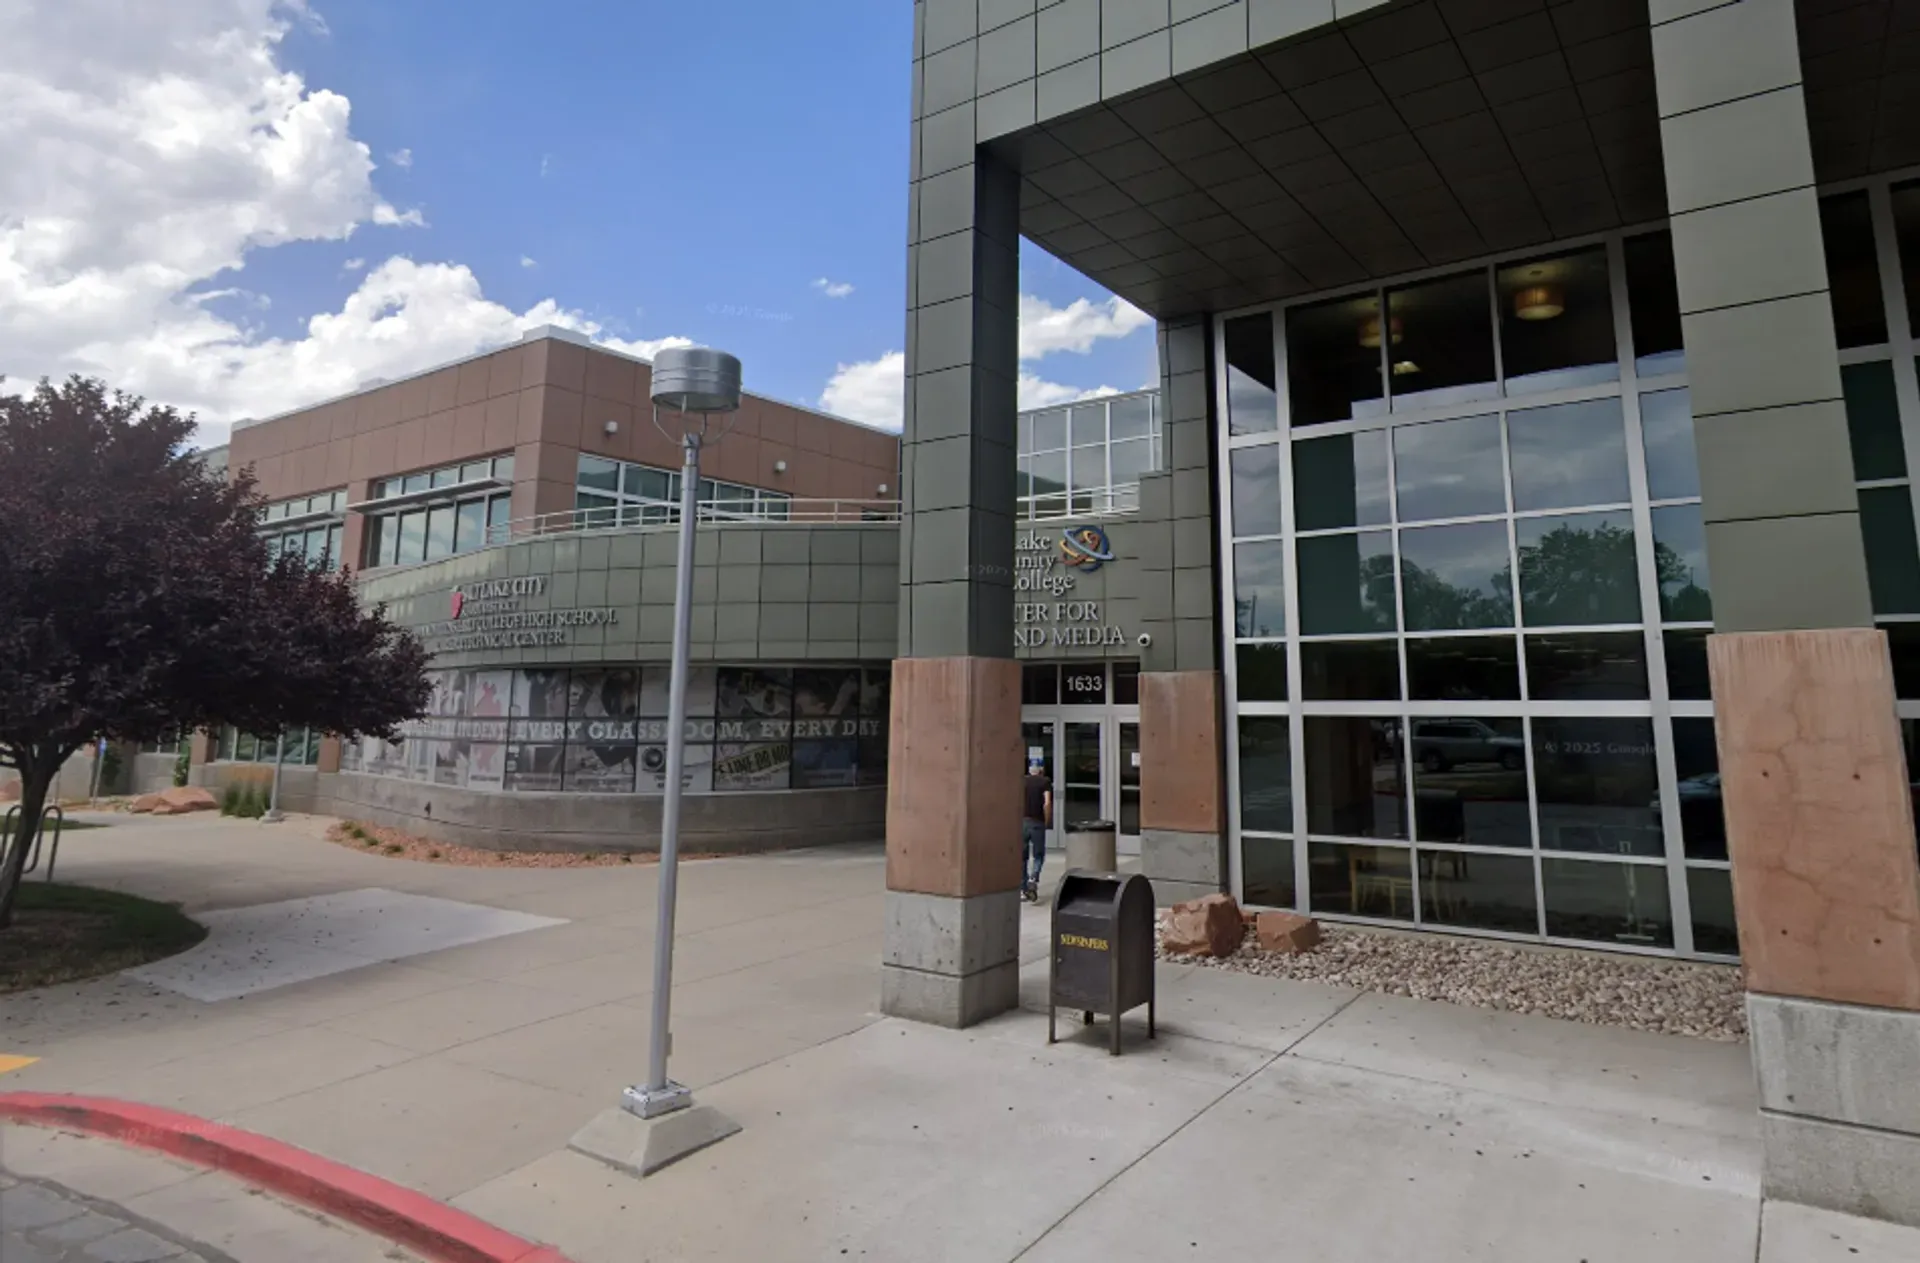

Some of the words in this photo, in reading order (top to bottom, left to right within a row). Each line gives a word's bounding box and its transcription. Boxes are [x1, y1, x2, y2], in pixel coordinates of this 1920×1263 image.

[512, 577, 545, 596] CITY
[556, 607, 618, 625] SCHOOL
[1055, 602, 1098, 621] FOR
[512, 630, 563, 647] CENTER
[1052, 626, 1126, 646] MEDIA
[1067, 675, 1102, 692] 1633
[517, 721, 582, 740] EVERY
[759, 721, 839, 739] EVERY
[842, 720, 881, 737] DAY
[1060, 933, 1109, 951] NEWSPAPERS
